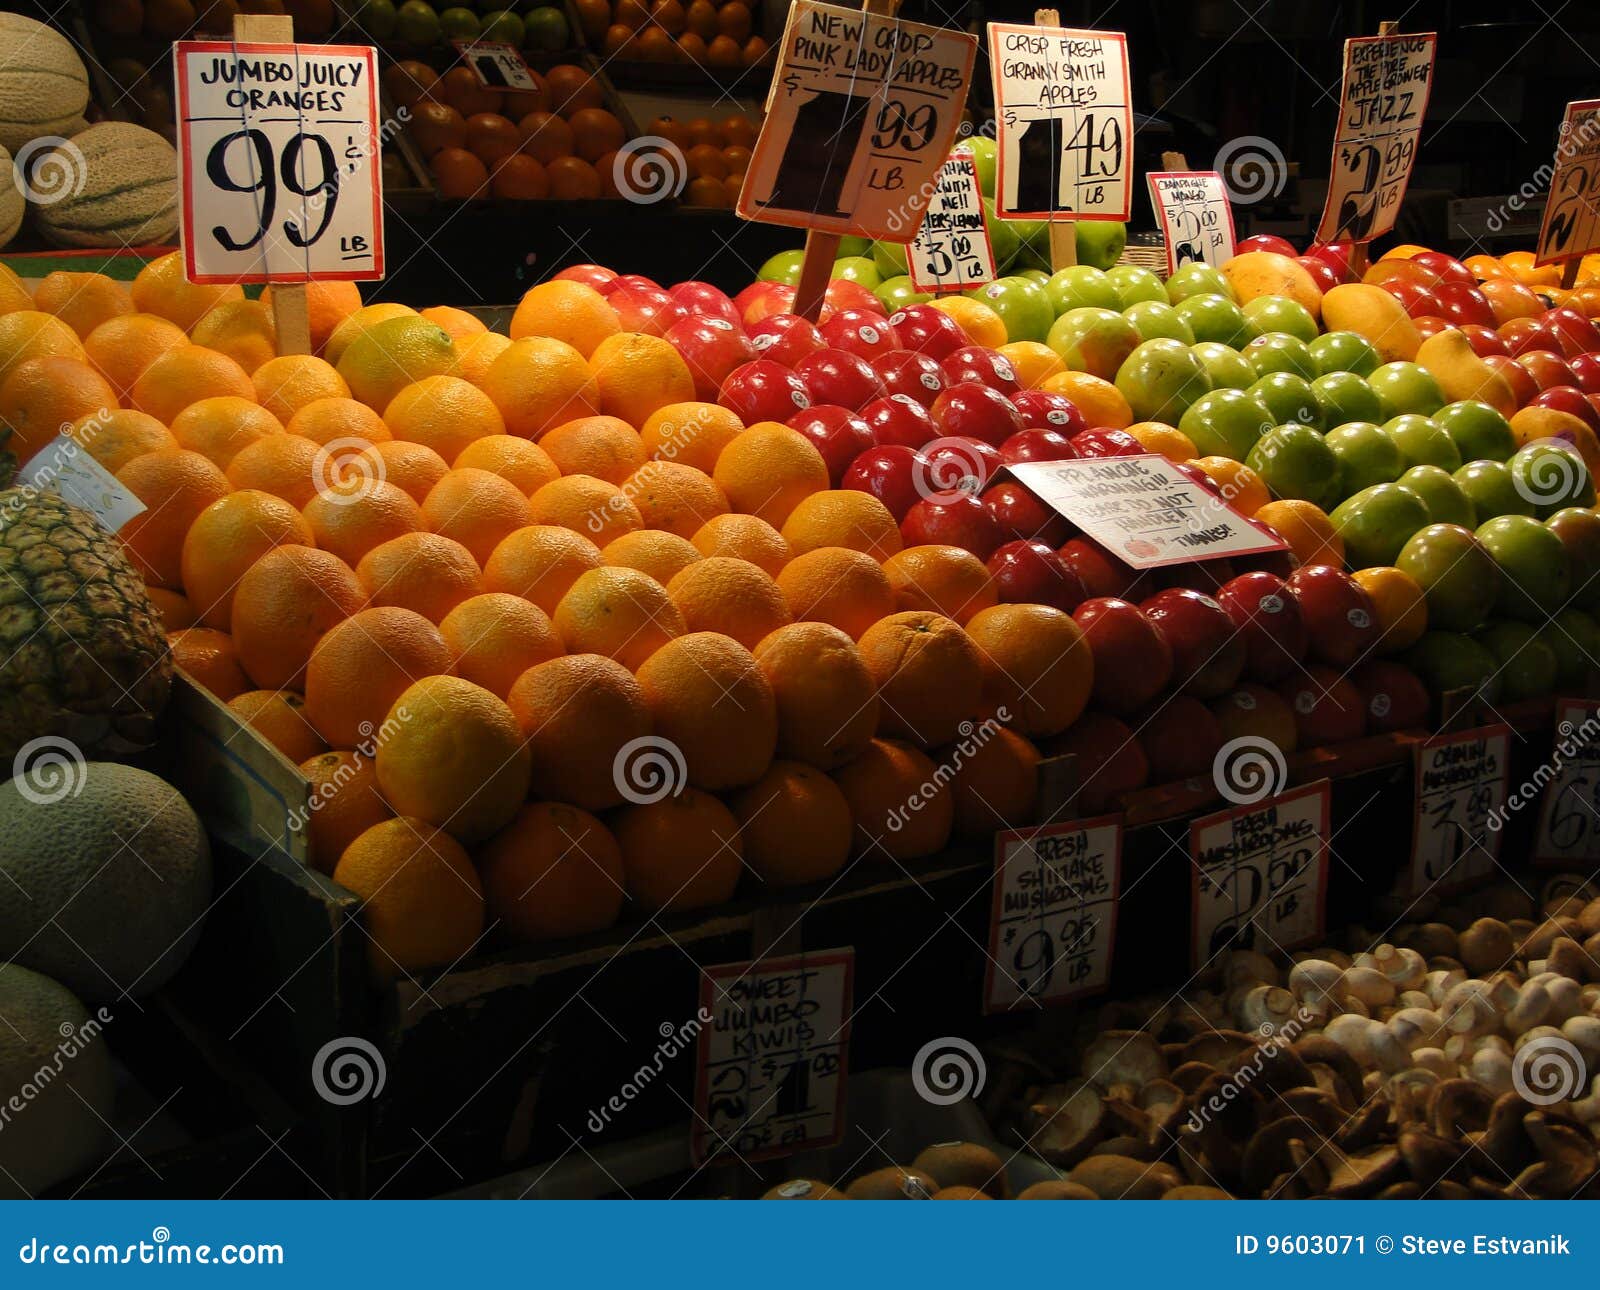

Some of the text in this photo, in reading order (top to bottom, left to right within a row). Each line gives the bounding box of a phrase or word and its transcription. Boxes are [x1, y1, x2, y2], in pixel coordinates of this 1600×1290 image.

[811, 12, 863, 42] NEW
[1006, 35, 1104, 57] CRISP FRESH
[200, 58, 362, 88] JUMBO JUICY
[794, 38, 962, 92] PINK LADY APPLES
[1003, 59, 1105, 80] GRANNY SMITH
[226, 90, 345, 111] ORANGES
[1039, 86, 1097, 103] APPLES
[1348, 92, 1416, 129] JAZZ
[1085, 187, 1104, 205] LB
[341, 235, 368, 253] LB
[968, 261, 984, 278] LB
[1153, 492, 1193, 509] NOT
[1036, 831, 1088, 863] FRESH
[729, 972, 818, 1000] SWEET
[715, 1001, 820, 1032] JUMBO
[734, 1022, 815, 1055] KIWIS
